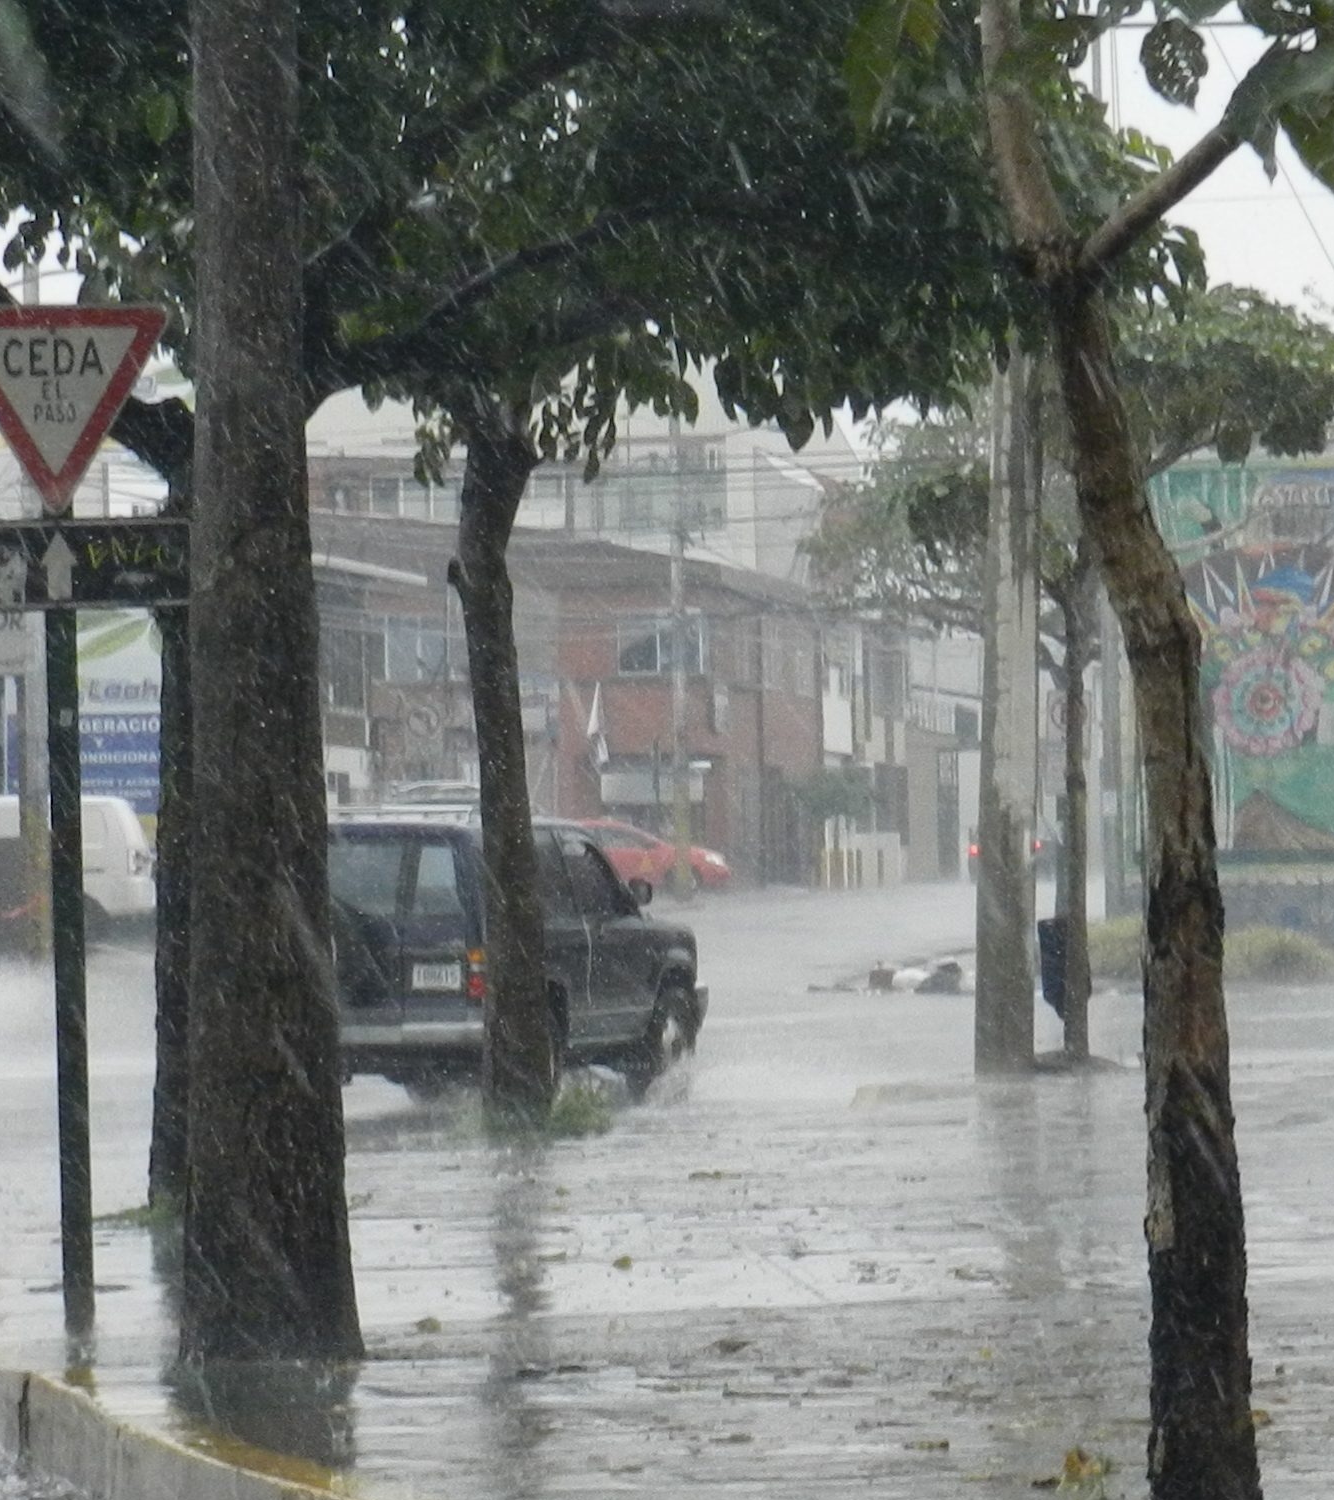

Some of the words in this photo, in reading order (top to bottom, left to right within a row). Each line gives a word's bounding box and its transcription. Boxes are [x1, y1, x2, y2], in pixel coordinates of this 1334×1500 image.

[3, 336, 103, 377] CEDA
[42, 380, 63, 401] EL
[33, 403, 77, 422] PASO
[79, 716, 160, 733] GERACIÓ
